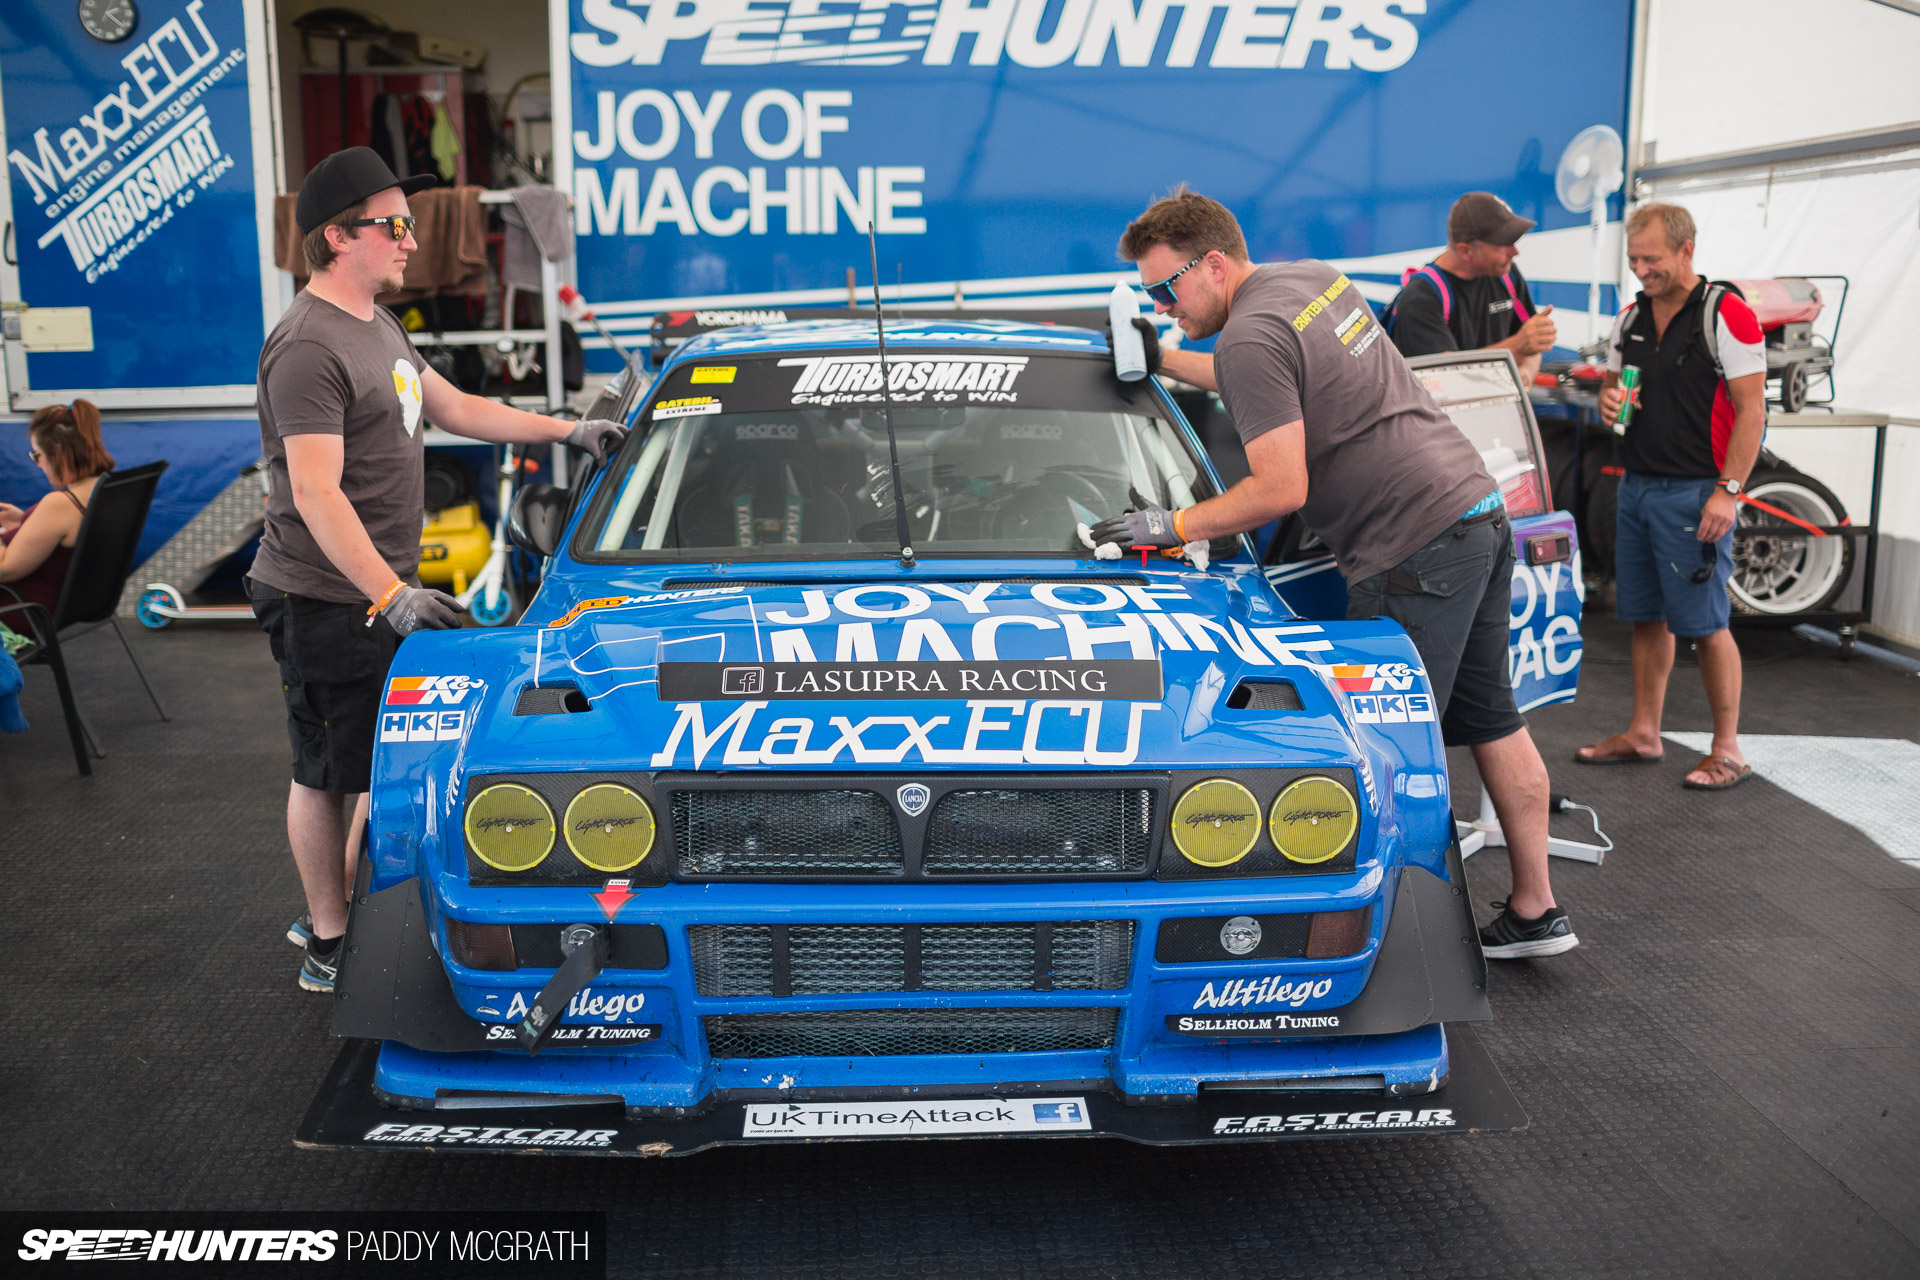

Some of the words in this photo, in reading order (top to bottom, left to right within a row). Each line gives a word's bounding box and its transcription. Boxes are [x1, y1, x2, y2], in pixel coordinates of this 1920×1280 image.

[7, 0, 219, 205] MaxxECU
[45, 159, 112, 218] engine
[113, 48, 246, 162] management
[573, 89, 732, 161] JOY
[741, 89, 852, 161] OF
[38, 104, 221, 272] TURBOSMART
[574, 166, 927, 237] MACHINE
[86, 204, 174, 284] Engineered
[176, 189, 195, 208] to
[197, 153, 235, 189] WIN
[695, 311, 788, 326] YOKOHAMA
[777, 355, 1029, 393] TURBOSMART
[655, 396, 713, 409] GATEBIL
[933, 391, 958, 402] to
[968, 390, 1018, 402] WIN
[666, 407, 706, 415] EXTREME
[765, 583, 1003, 624] JOY
[1030, 583, 1197, 612] OF
[774, 670, 948, 692] LASUPRA
[959, 669, 1107, 692] RACING
[1353, 695, 1432, 717] HKS
[382, 712, 464, 736] HKS
[651, 700, 1162, 770] MaxxECU
[905, 794, 923, 803] LANCIA
[1193, 975, 1332, 1009] Alltilego
[365, 1123, 618, 1141] FASTCAR
[1213, 1109, 1453, 1130] FASTCAR
